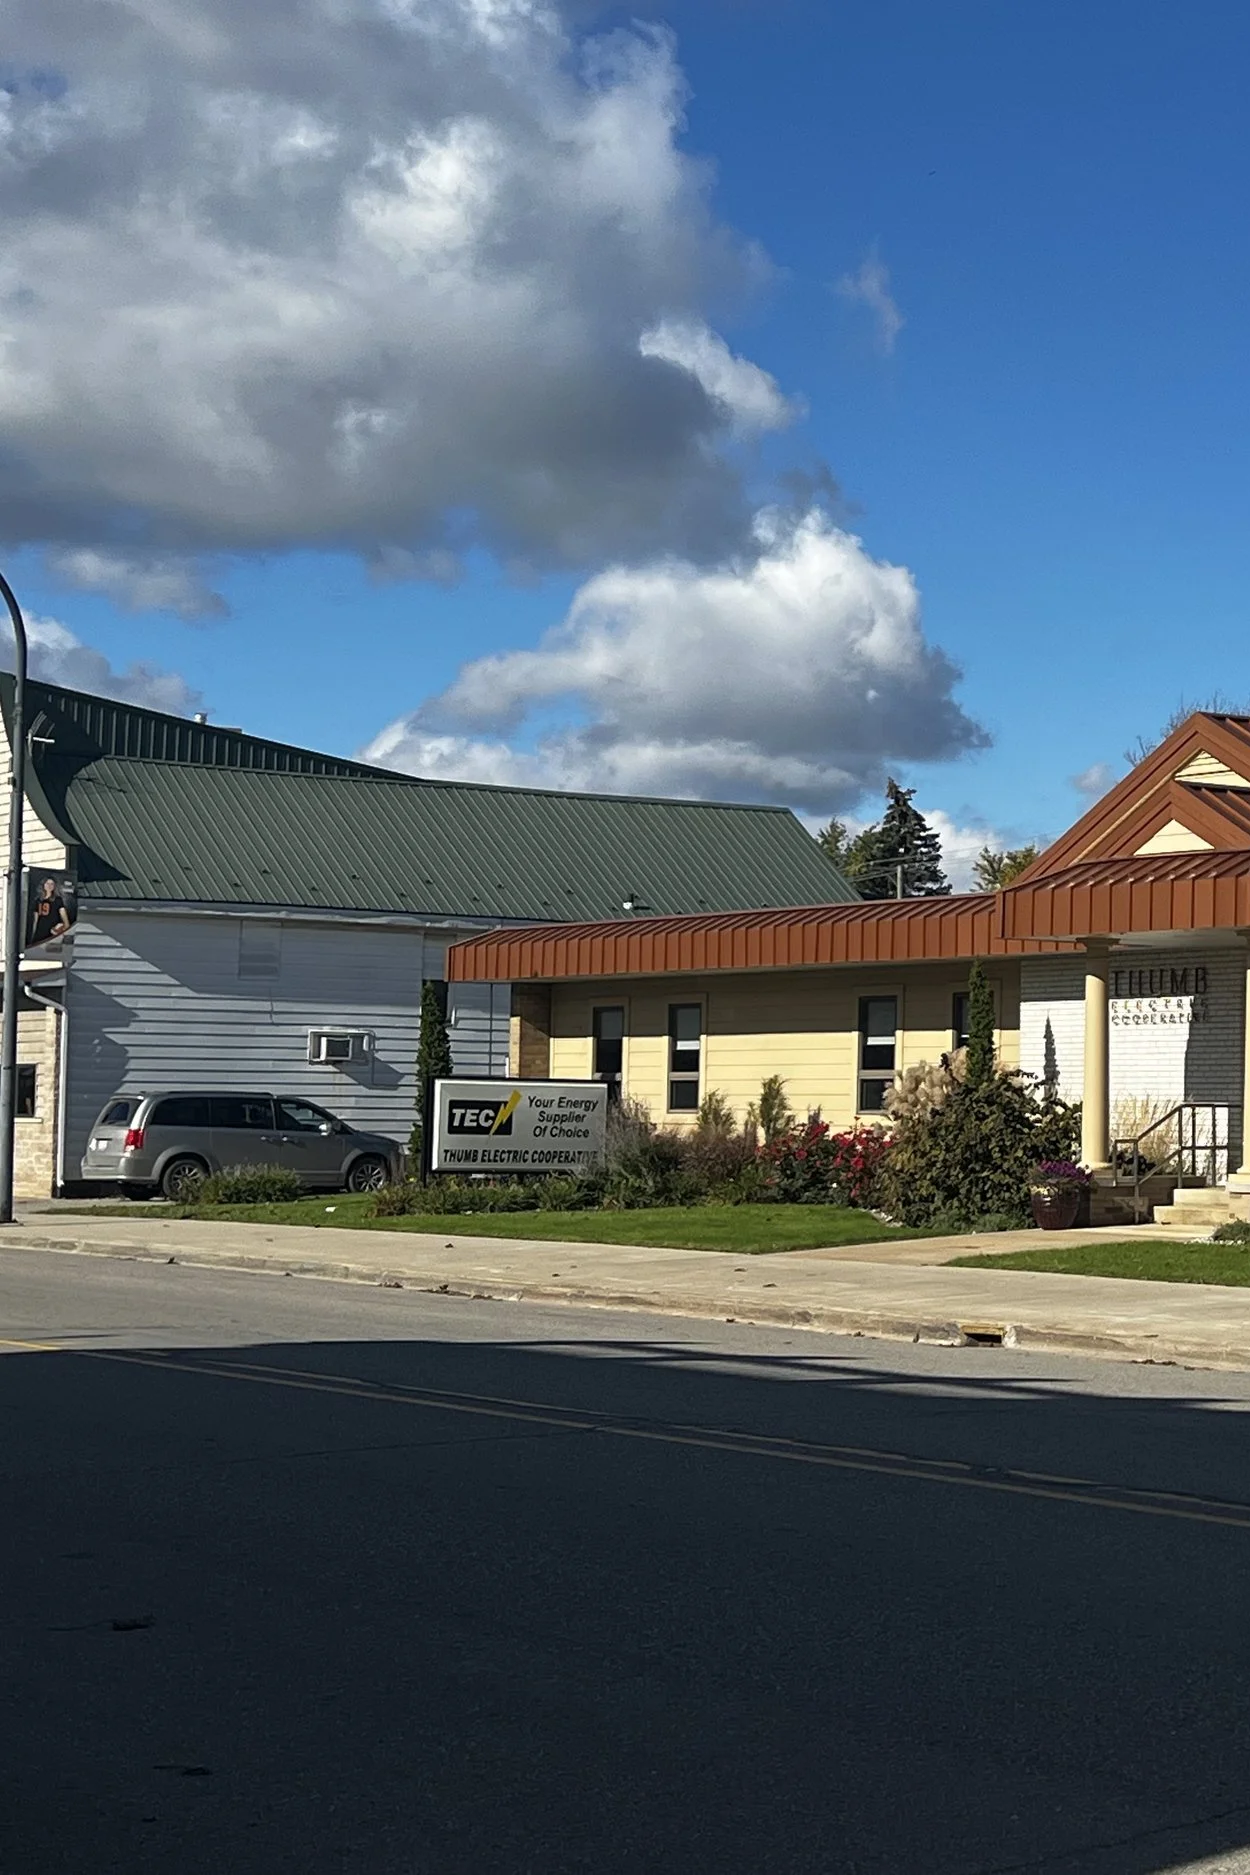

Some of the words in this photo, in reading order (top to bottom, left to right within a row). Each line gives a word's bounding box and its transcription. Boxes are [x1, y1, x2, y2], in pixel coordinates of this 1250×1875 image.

[38, 902, 51, 916] 19
[1111, 967, 1208, 996] THUMB
[528, 1096, 555, 1108] Your
[558, 1097, 599, 1112] Energy
[451, 1108, 495, 1128] TEC
[537, 1111, 587, 1124] Supplier
[533, 1126, 546, 1138] Of
[550, 1125, 590, 1138] Choice
[443, 1149, 478, 1163] THUMB
[481, 1150, 529, 1163] ELECTRIC
